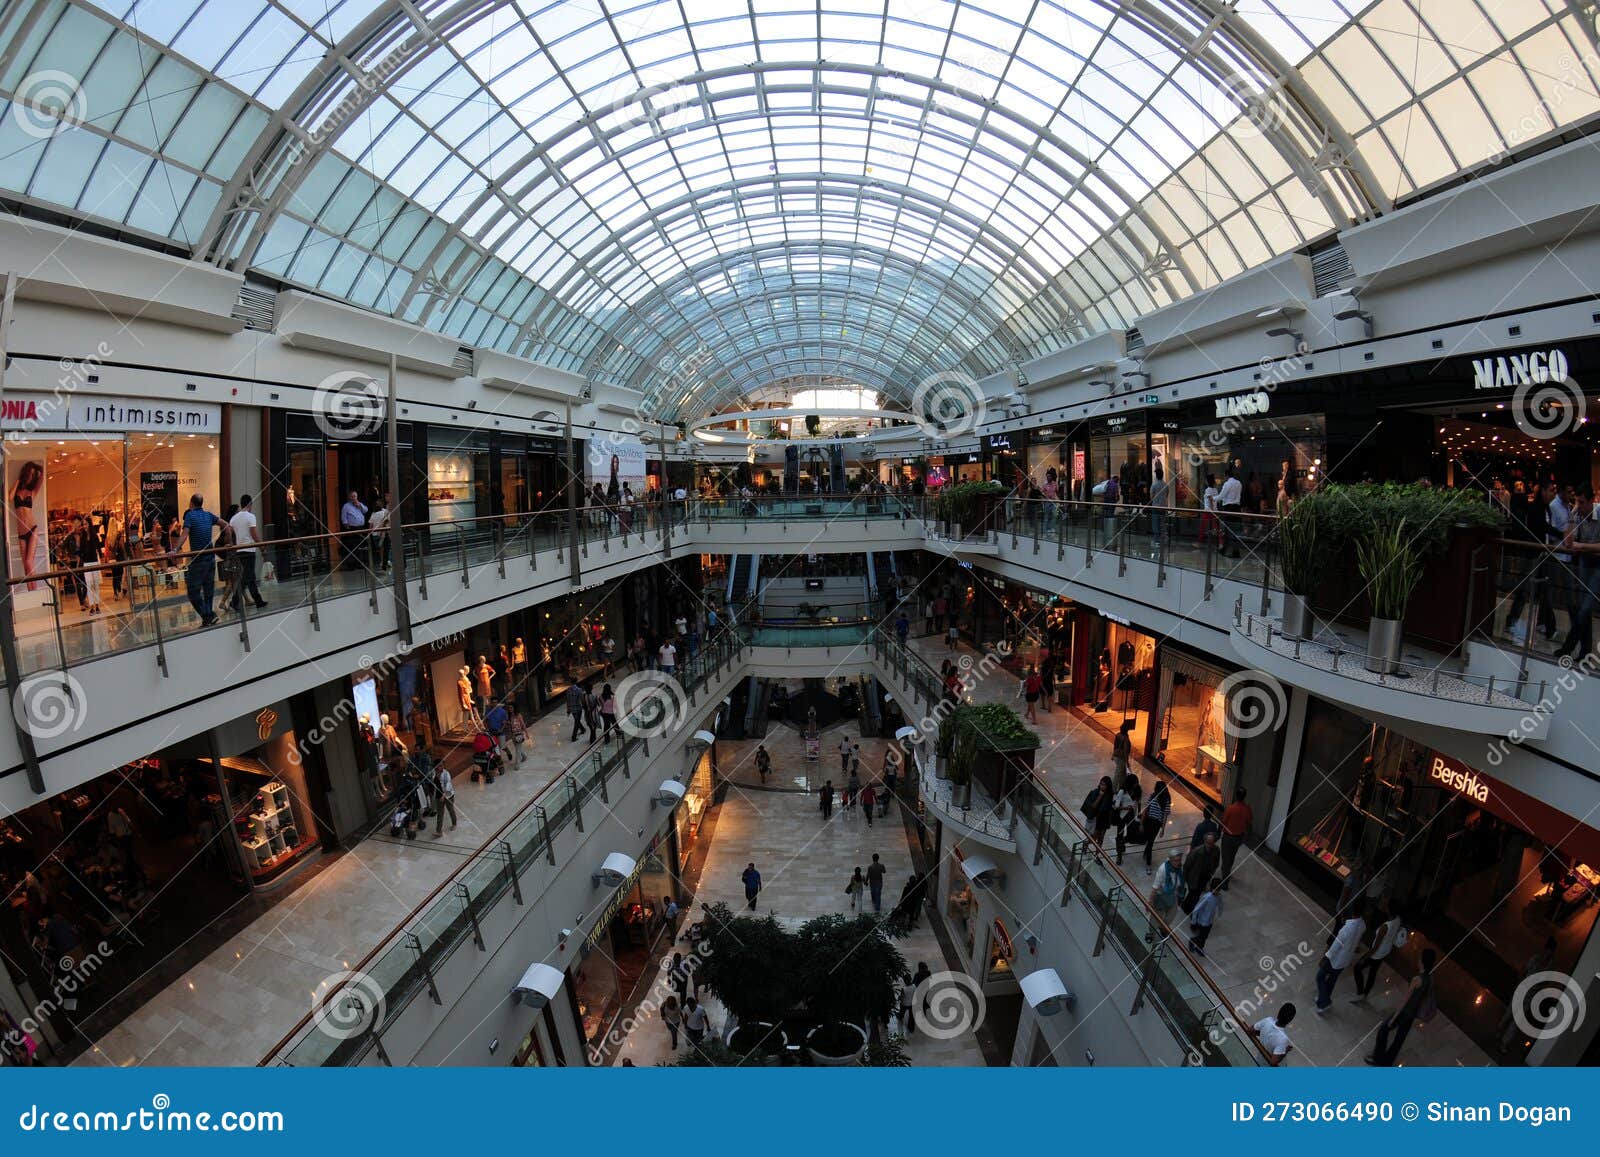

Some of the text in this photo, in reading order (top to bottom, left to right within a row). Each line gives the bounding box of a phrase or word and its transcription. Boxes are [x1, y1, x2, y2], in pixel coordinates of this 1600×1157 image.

[1471, 348, 1569, 390] MANGO
[86, 404, 209, 427] intimissimi
[1214, 391, 1270, 419] MANGO
[1431, 757, 1489, 803] Bershka
